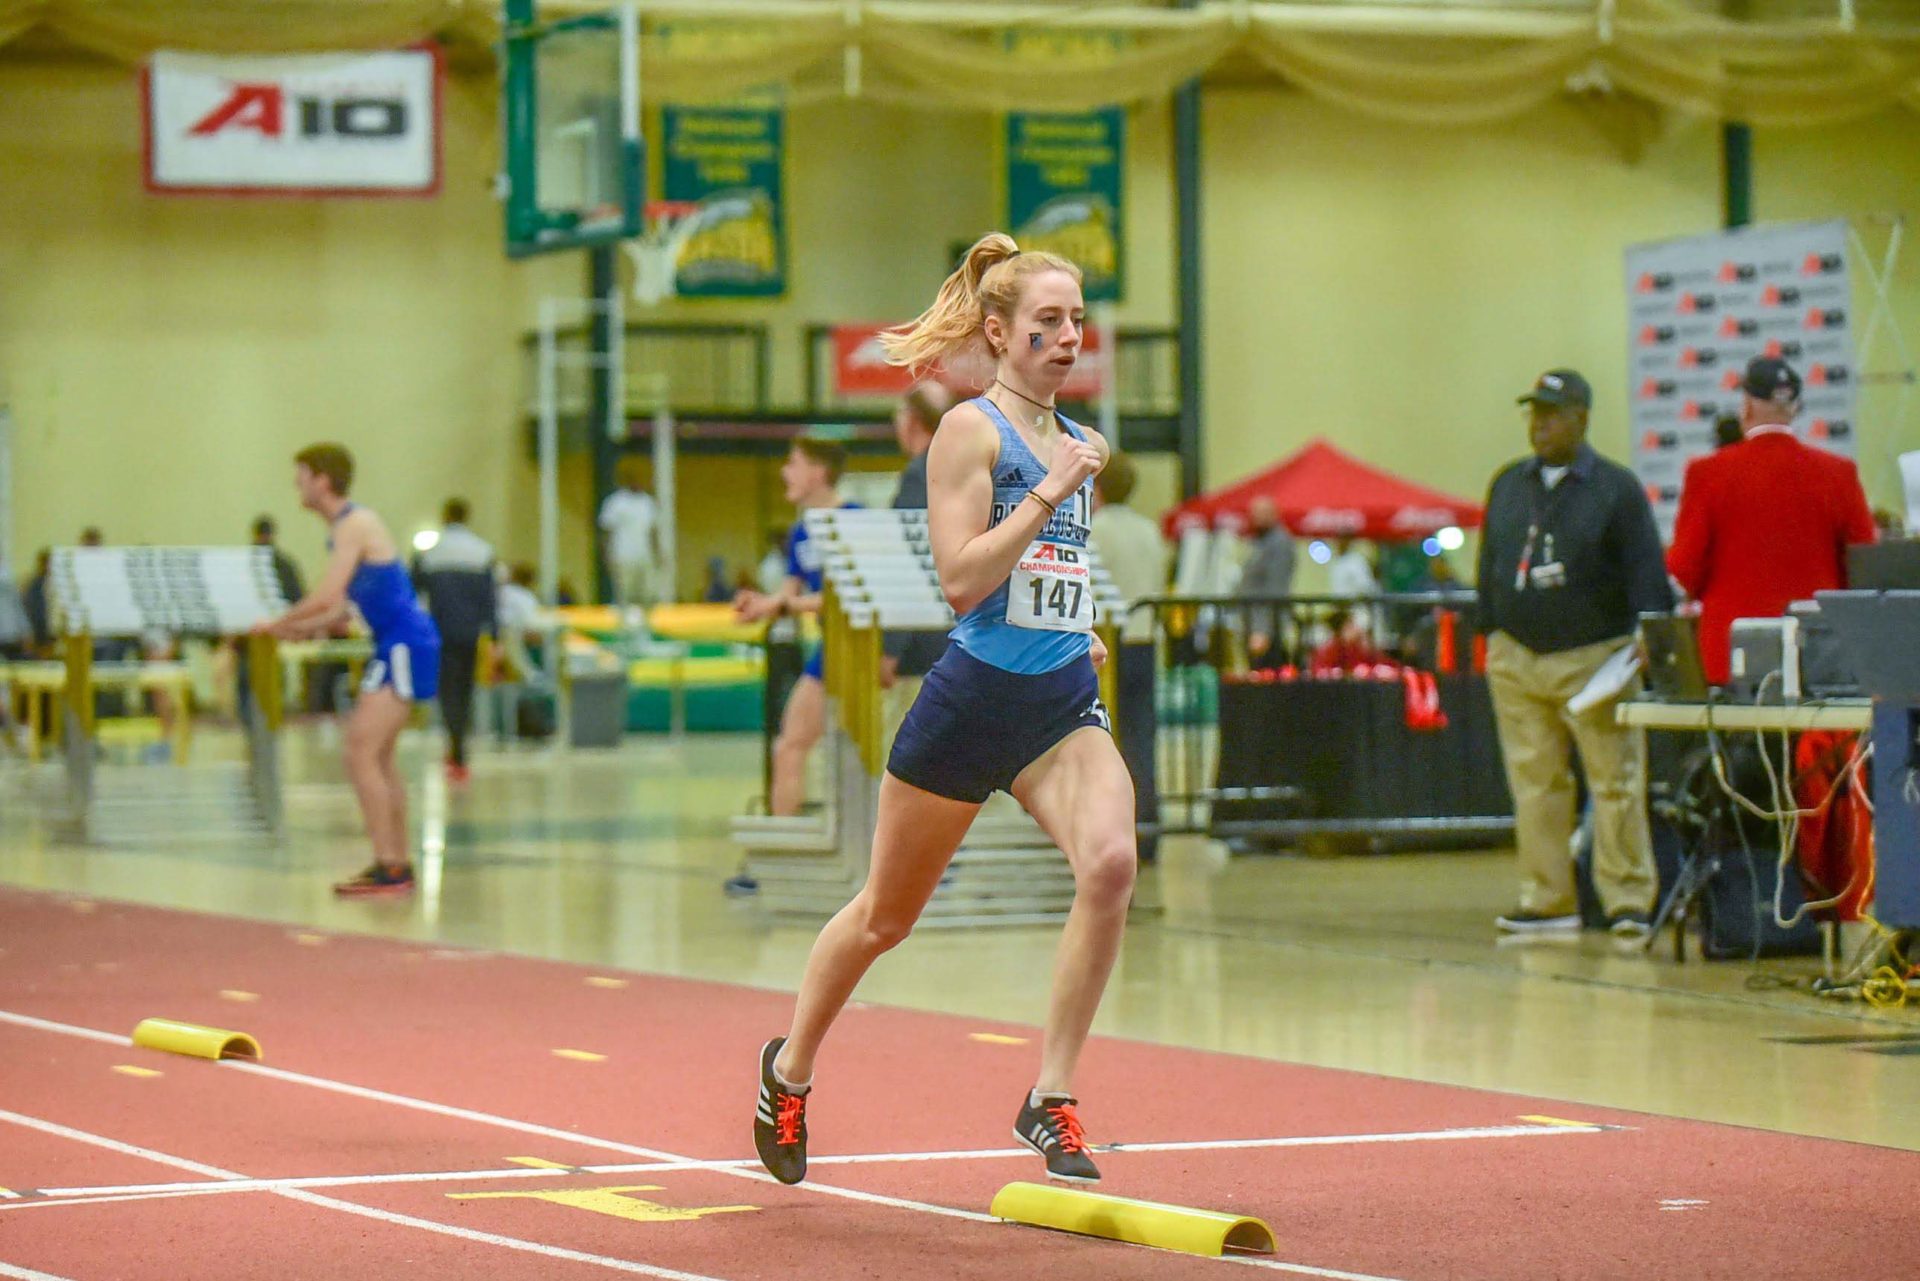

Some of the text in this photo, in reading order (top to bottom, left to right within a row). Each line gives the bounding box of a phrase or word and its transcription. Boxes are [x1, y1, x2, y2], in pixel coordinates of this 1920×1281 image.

[187, 82, 407, 137] A10
[1032, 543, 1079, 563] A10
[1020, 561, 1088, 577] CHAMPIONSHIPS
[1029, 577, 1082, 619] 147
